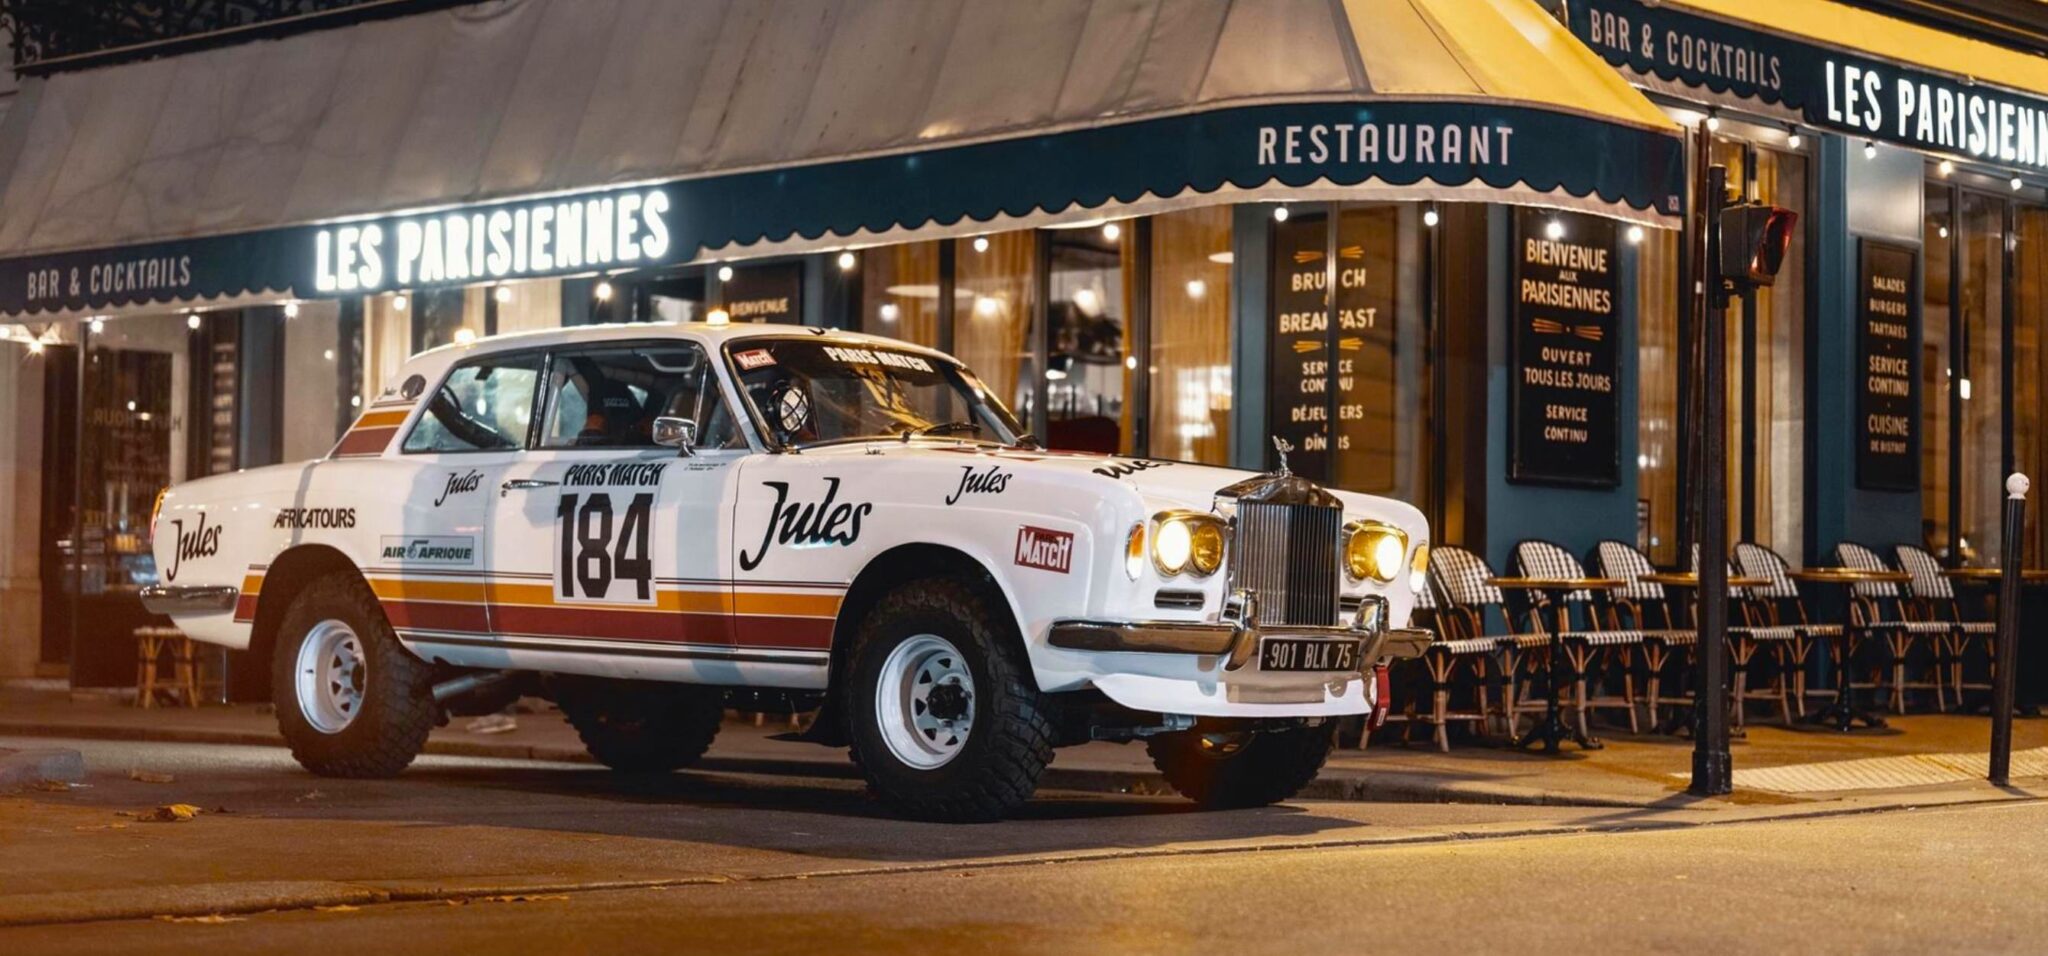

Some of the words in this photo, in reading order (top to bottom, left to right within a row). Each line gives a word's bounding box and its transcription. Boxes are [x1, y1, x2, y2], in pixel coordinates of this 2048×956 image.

[1590, 8, 1632, 53] BAR
[1641, 23, 1655, 59] &
[1666, 30, 1781, 91] COCKTAILS
[1825, 60, 1882, 131] LES
[1258, 124, 1514, 166] RESTAURANT
[315, 225, 384, 291] LES
[396, 190, 670, 284] PARISIENNES
[1526, 238, 1608, 273] BIENVENUE
[28, 269, 59, 299] BAR
[69, 268, 81, 296] &
[90, 256, 191, 293] COCKTAILS
[1292, 268, 1366, 292] BRUCH
[1558, 269, 1578, 282] AUX
[1872, 275, 1906, 294] SALADES
[1521, 279, 1611, 314] PARISIENNES
[1869, 298, 1907, 317] BURGERS
[1869, 321, 1908, 339] TARTARES
[823, 347, 879, 365] PARIS
[873, 351, 934, 373] MATCH
[1542, 346, 1591, 366] OUVERT
[1869, 355, 1908, 376] SERVICE
[1524, 367, 1553, 386] TOUS
[1555, 371, 1574, 389] LES
[1576, 372, 1611, 392] JOURS
[1868, 377, 1909, 397] CONTINU
[1292, 404, 1363, 422] DÉJEUERS
[1546, 404, 1588, 423] SERVICE
[1868, 413, 1909, 437] CUISINE
[1544, 426, 1588, 443] CONTINU
[563, 463, 612, 486] PARIS
[607, 463, 667, 486] MATCH
[946, 465, 1013, 505] Jules
[435, 469, 484, 507] Jules
[274, 508, 355, 529] AFRICATOURS
[740, 477, 872, 571] Jules
[167, 512, 222, 581] Jules
[383, 547, 406, 559] AIR
[419, 547, 472, 560] AFRIQUE
[558, 493, 654, 600] 184
[1017, 530, 1071, 570] MATCH
[1270, 642, 1297, 668] 901
[1304, 643, 1330, 669] BLK
[1335, 643, 1352, 669] 75
